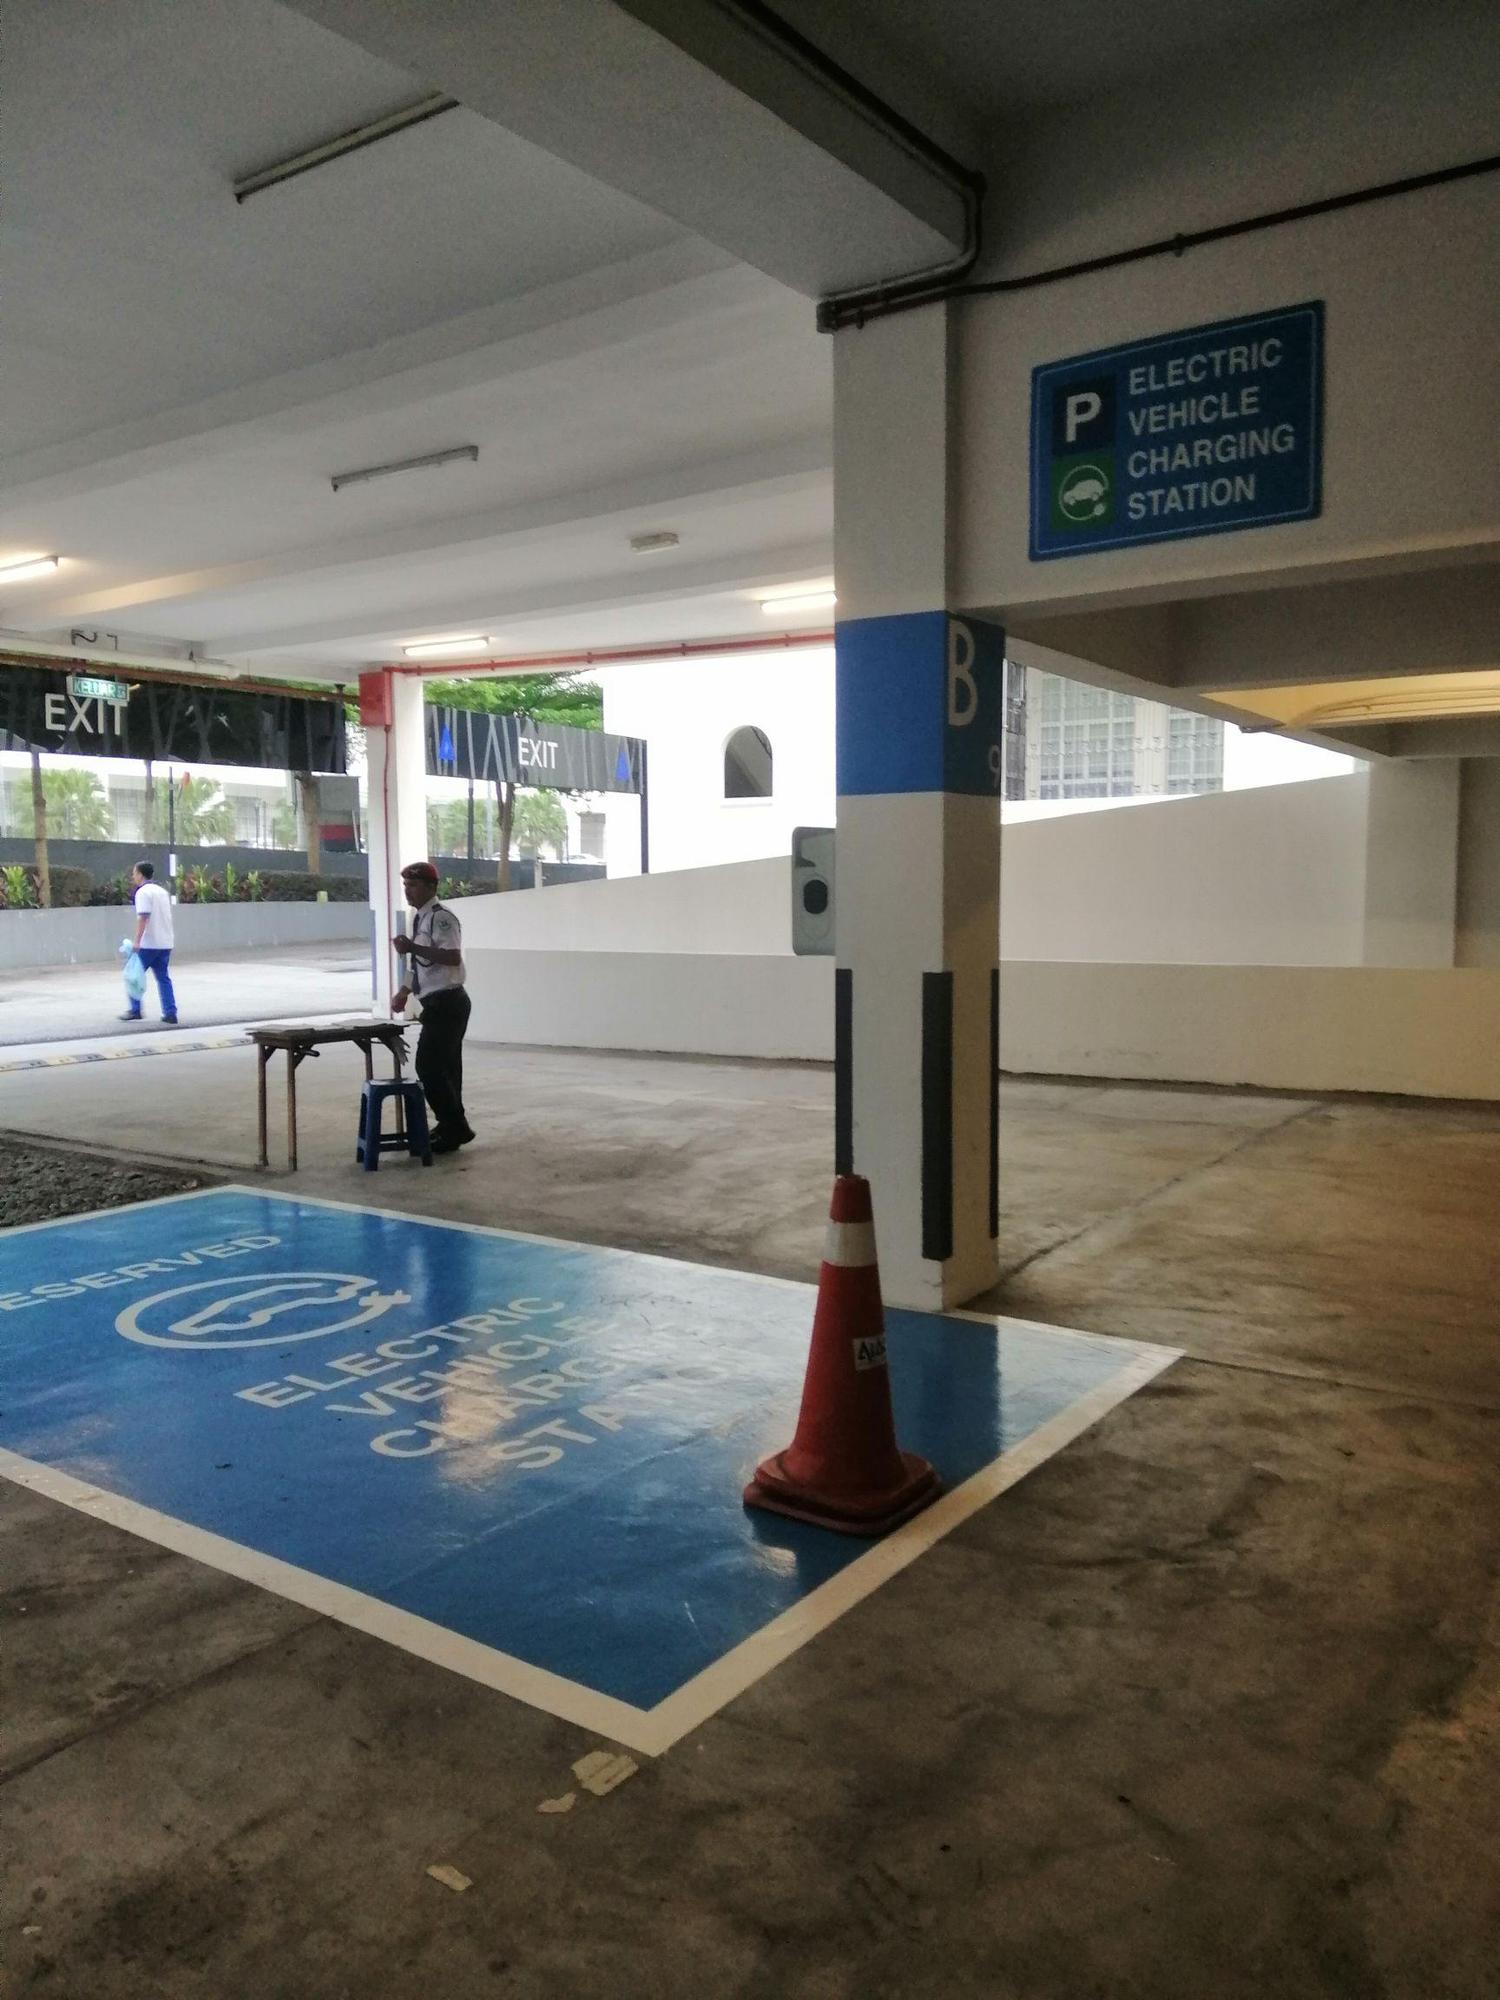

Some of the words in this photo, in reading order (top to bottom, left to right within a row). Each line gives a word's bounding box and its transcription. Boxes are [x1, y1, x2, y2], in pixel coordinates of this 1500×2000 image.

[1129, 338, 1283, 395] ELECTRIC
[1065, 391, 1102, 443] P
[1128, 386, 1260, 436] VEHICLE
[1127, 423, 1295, 479] CHARGING
[1127, 473, 1256, 520] STATION
[948, 619, 978, 727] B
[44, 692, 128, 736] EXIT
[517, 736, 559, 769] EXIT
[233, 1296, 564, 1408] ELECTRIC
[325, 1315, 618, 1416] VEHICLE
